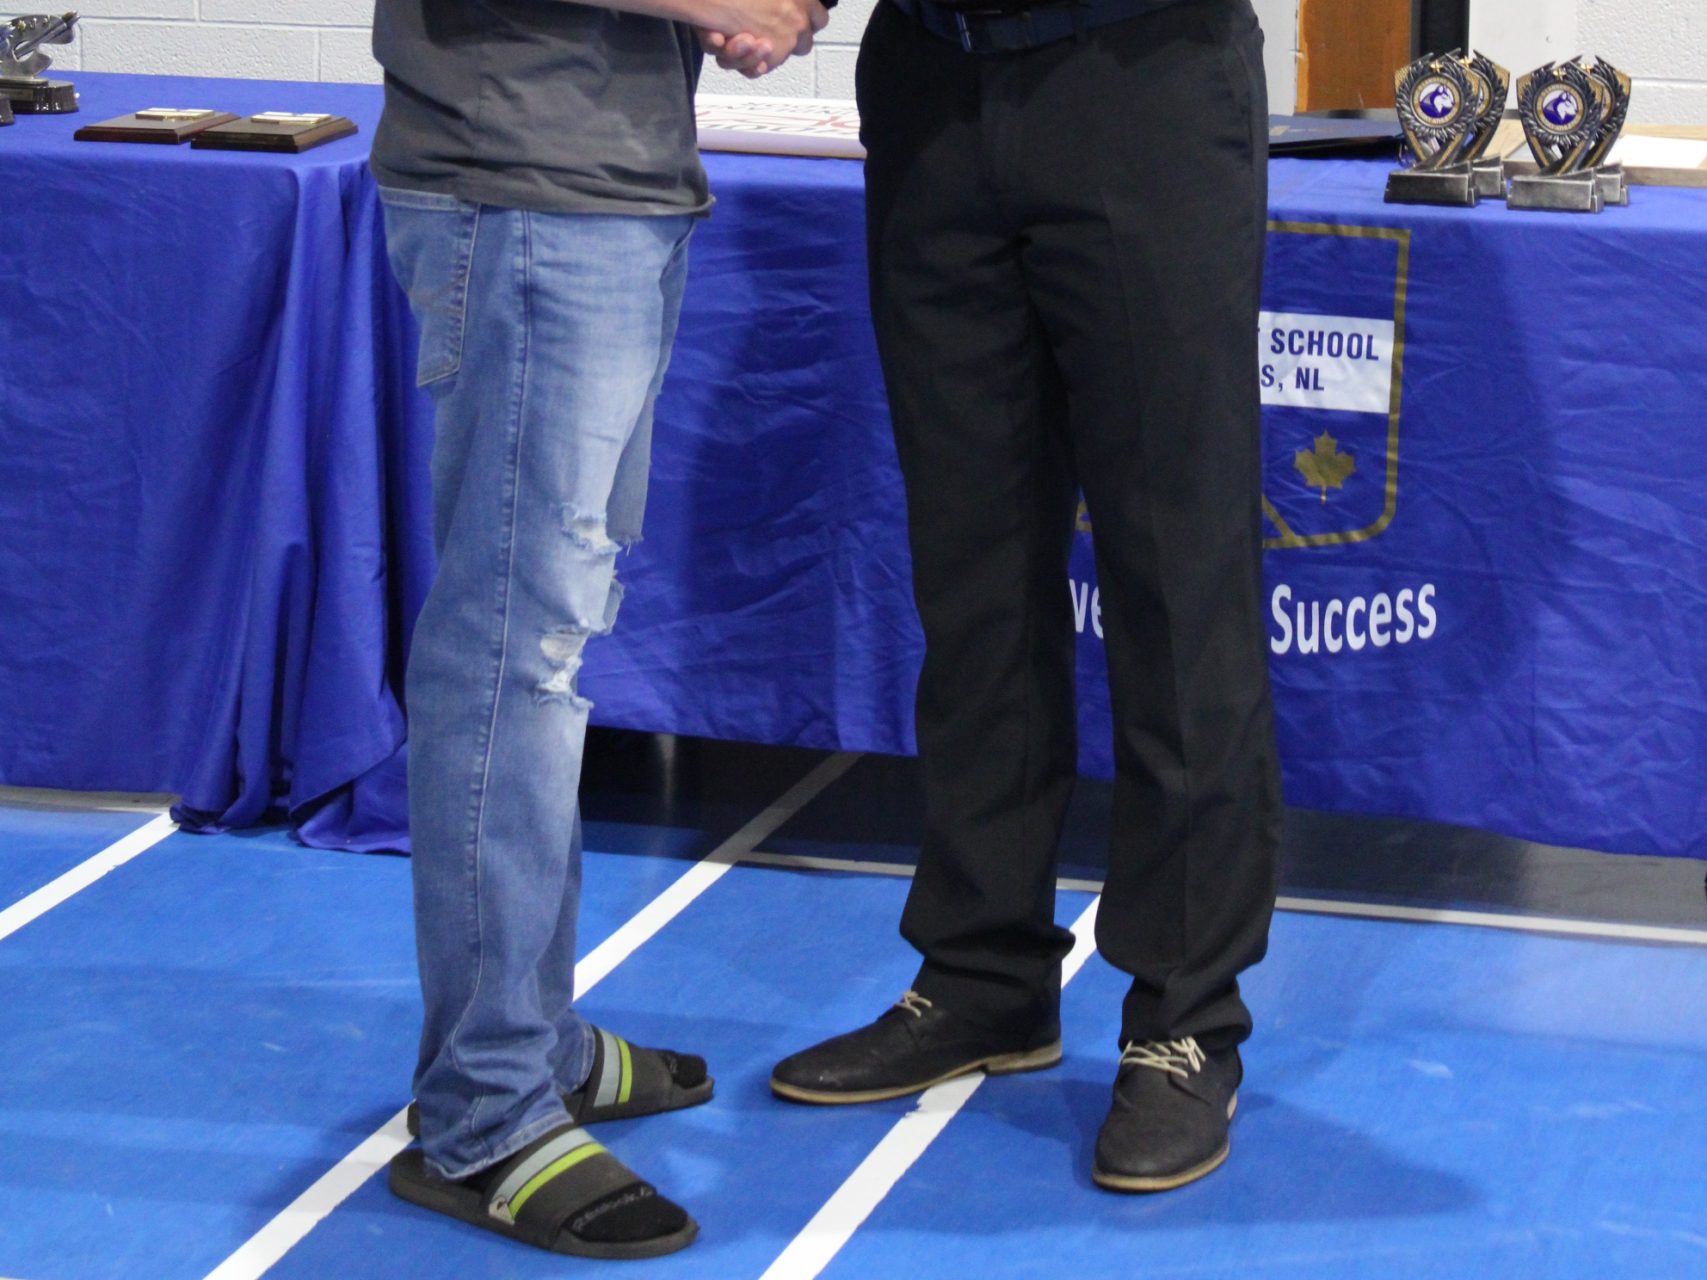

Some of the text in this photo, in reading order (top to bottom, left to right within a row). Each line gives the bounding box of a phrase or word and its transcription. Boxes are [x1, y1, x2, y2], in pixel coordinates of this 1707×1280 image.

[1270, 328, 1379, 361] SCHOOL
[1296, 366, 1325, 391] NL
[1270, 583, 1437, 655] Success
